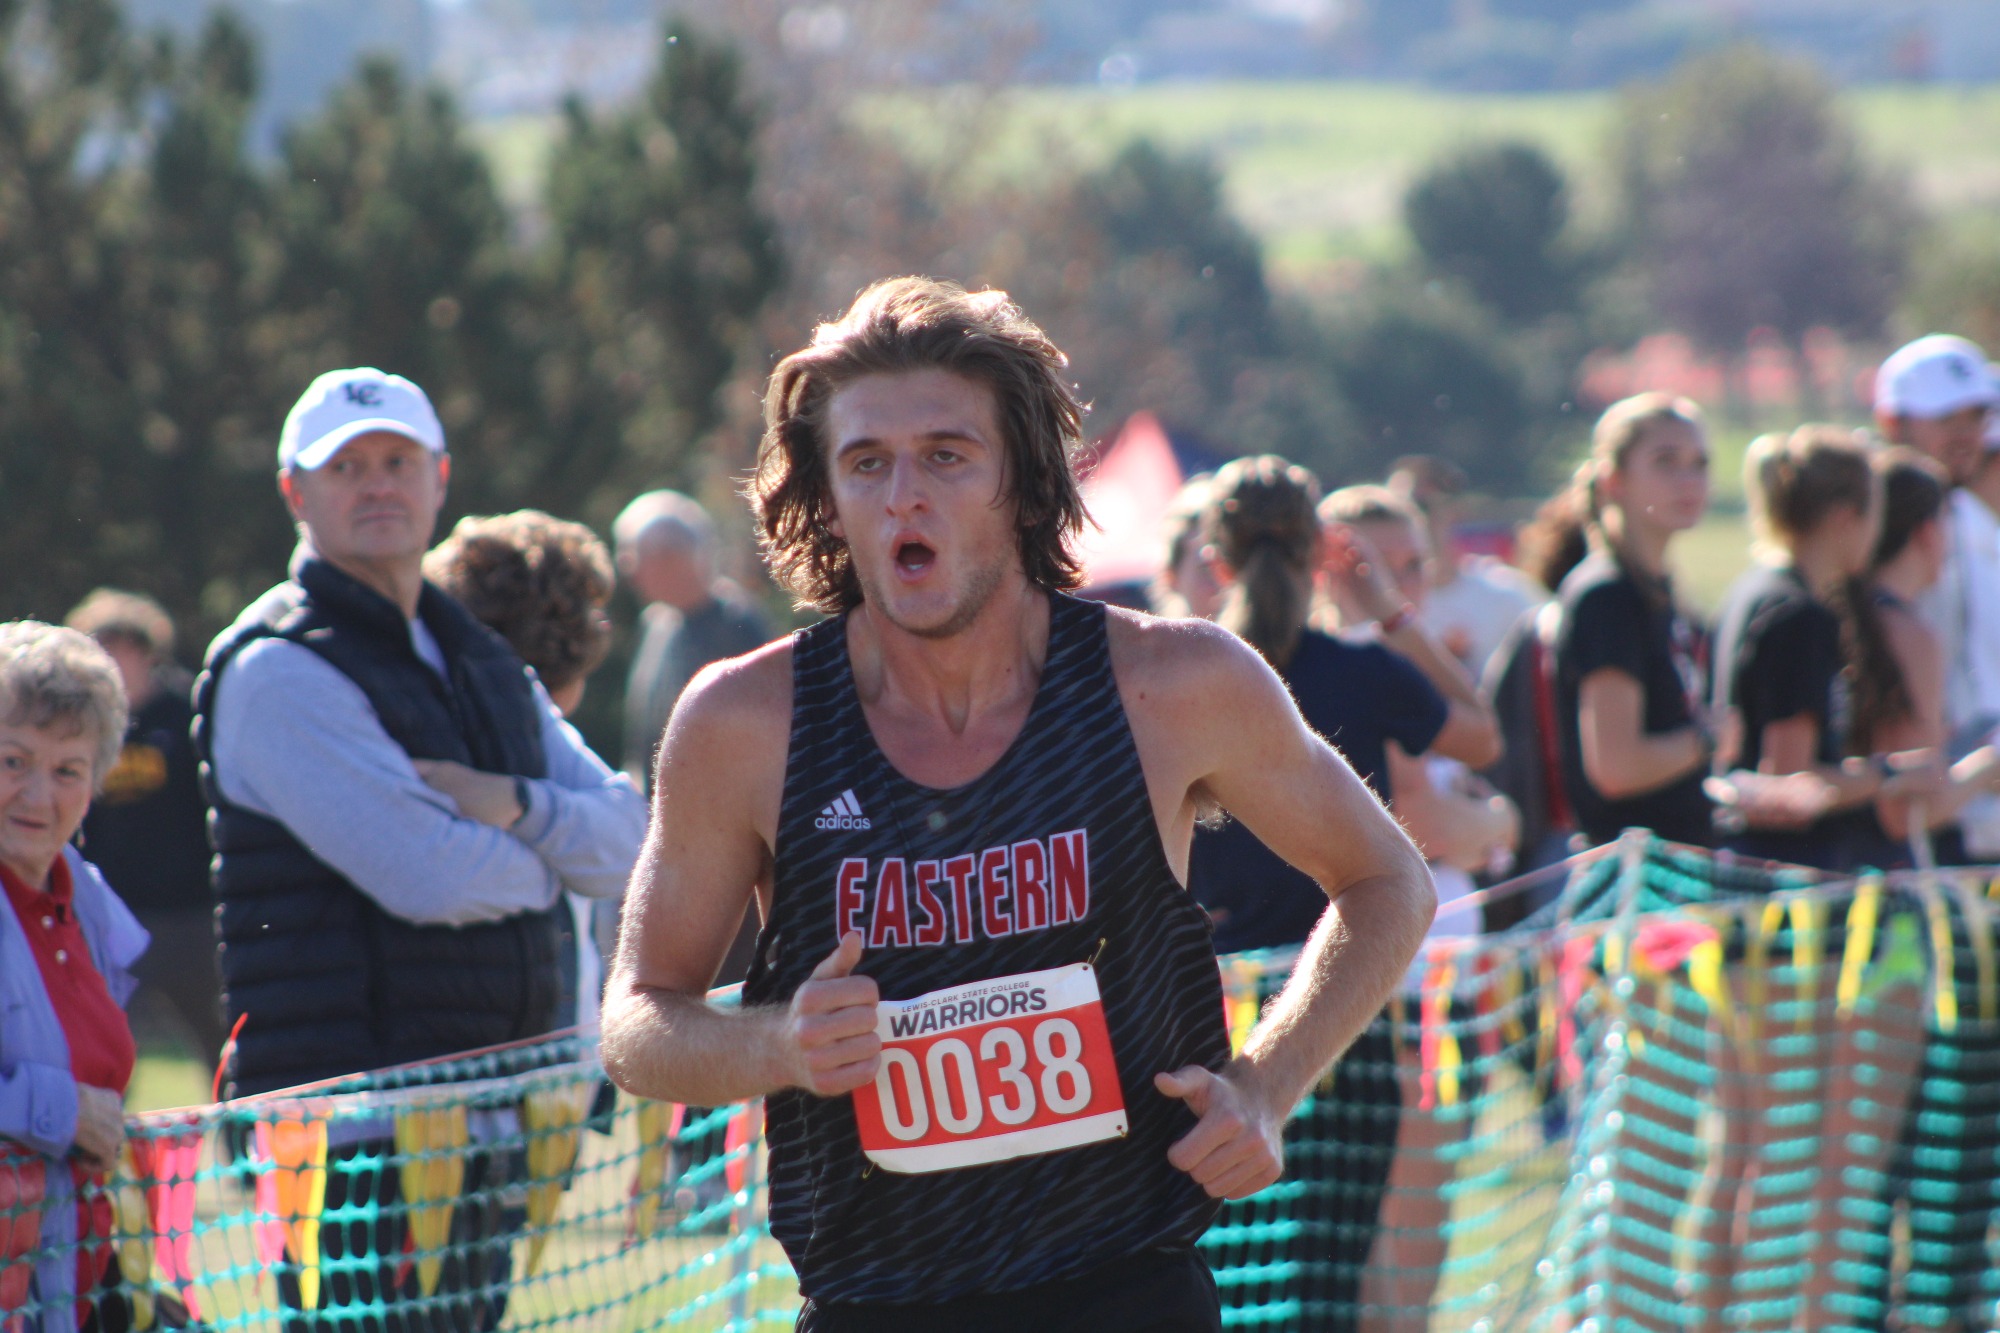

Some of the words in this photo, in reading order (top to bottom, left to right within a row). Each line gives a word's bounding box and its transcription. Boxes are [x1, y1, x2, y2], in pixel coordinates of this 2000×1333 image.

[814, 814, 871, 830] adidas
[836, 828, 1090, 949] EASTERN
[889, 987, 1047, 1038] WARRIORS
[902, 994, 959, 1013] LEWIS-CLARK
[962, 988, 988, 999] STATE
[990, 981, 1030, 993] COLLEGE
[874, 1018, 1092, 1142] 0038
